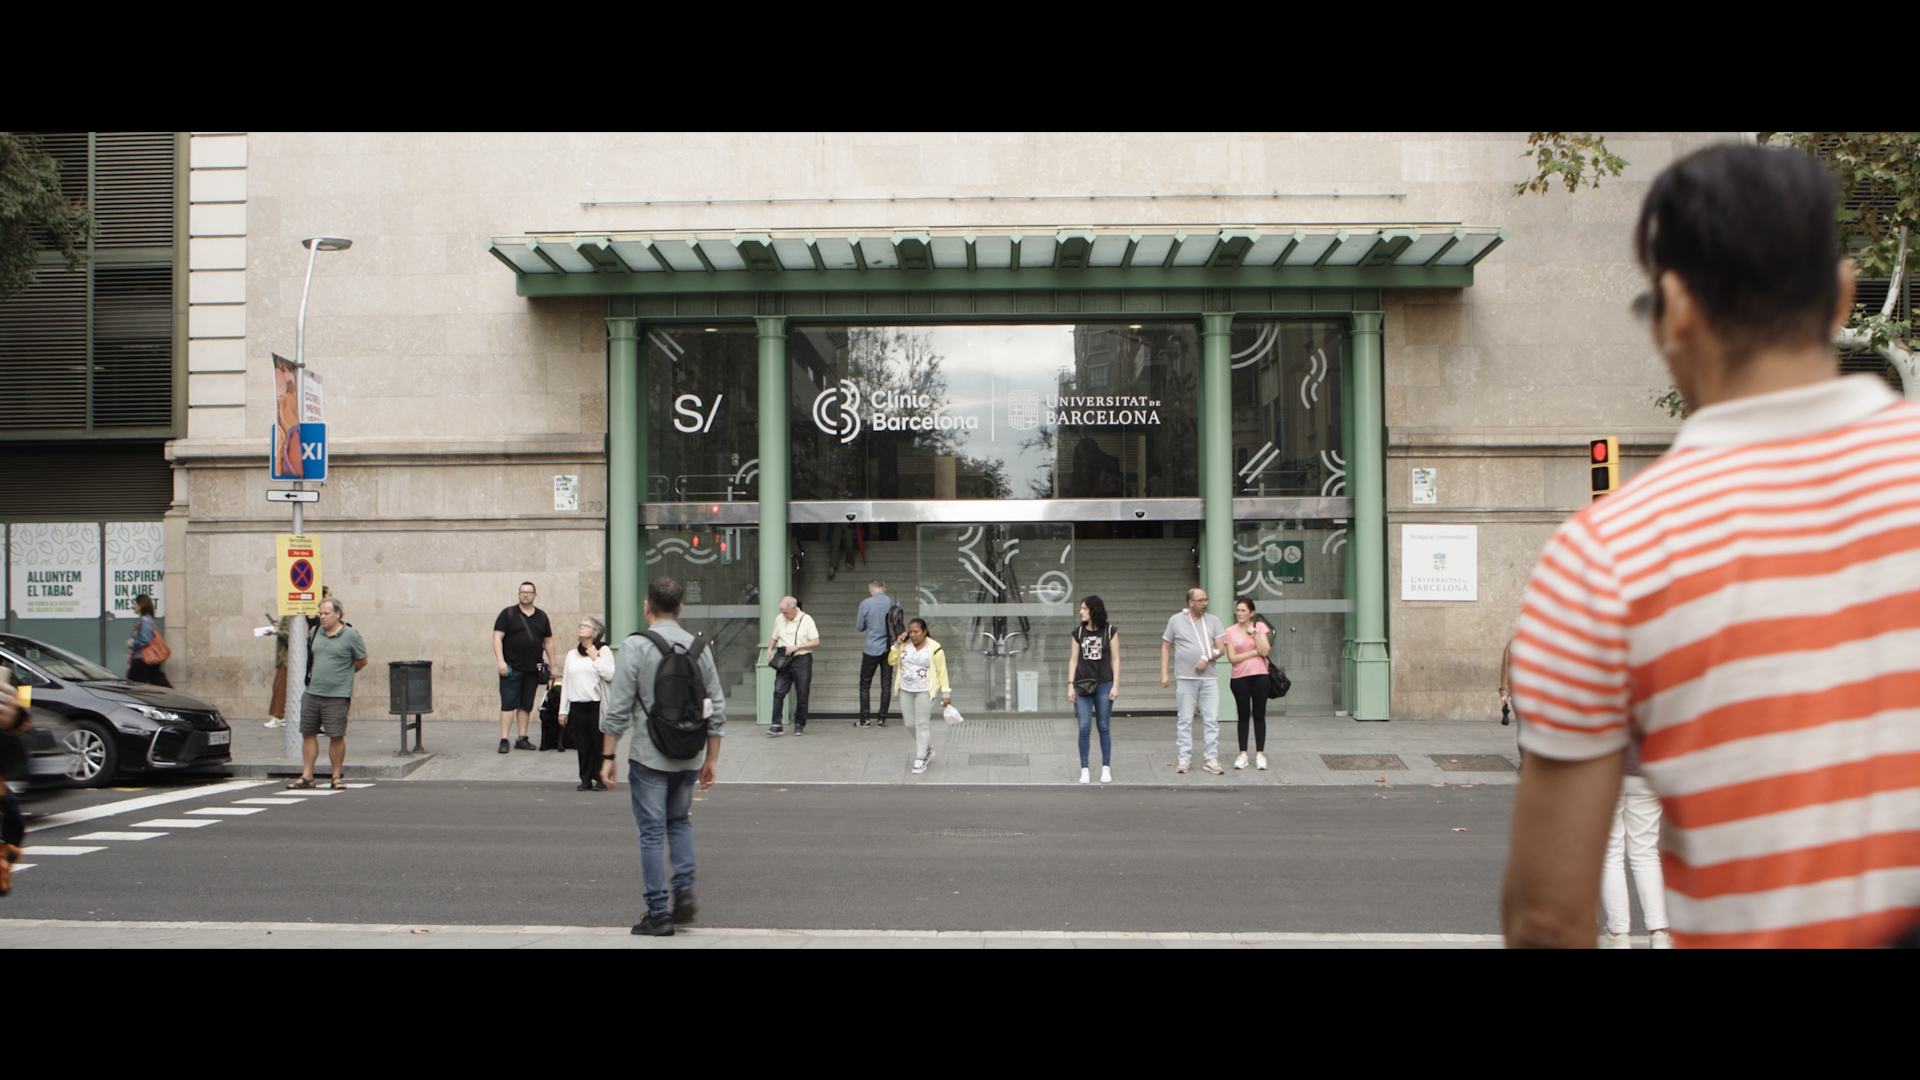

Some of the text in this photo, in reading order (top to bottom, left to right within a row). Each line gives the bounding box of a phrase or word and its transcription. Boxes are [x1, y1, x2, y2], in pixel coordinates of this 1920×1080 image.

[871, 389, 930, 409] Clínic
[1046, 395, 1148, 408] UNIVERSITAT
[673, 393, 723, 433] S/
[1046, 410, 1161, 425] BARCELONA
[873, 411, 979, 431] Barcelona
[302, 442, 322, 460] XI
[582, 501, 604, 512] 170
[27, 570, 82, 583] ALLUNYEM
[27, 584, 74, 597] EL TABAC
[114, 584, 154, 596] UN AIRE
[1410, 584, 1468, 592] BARCELONA
